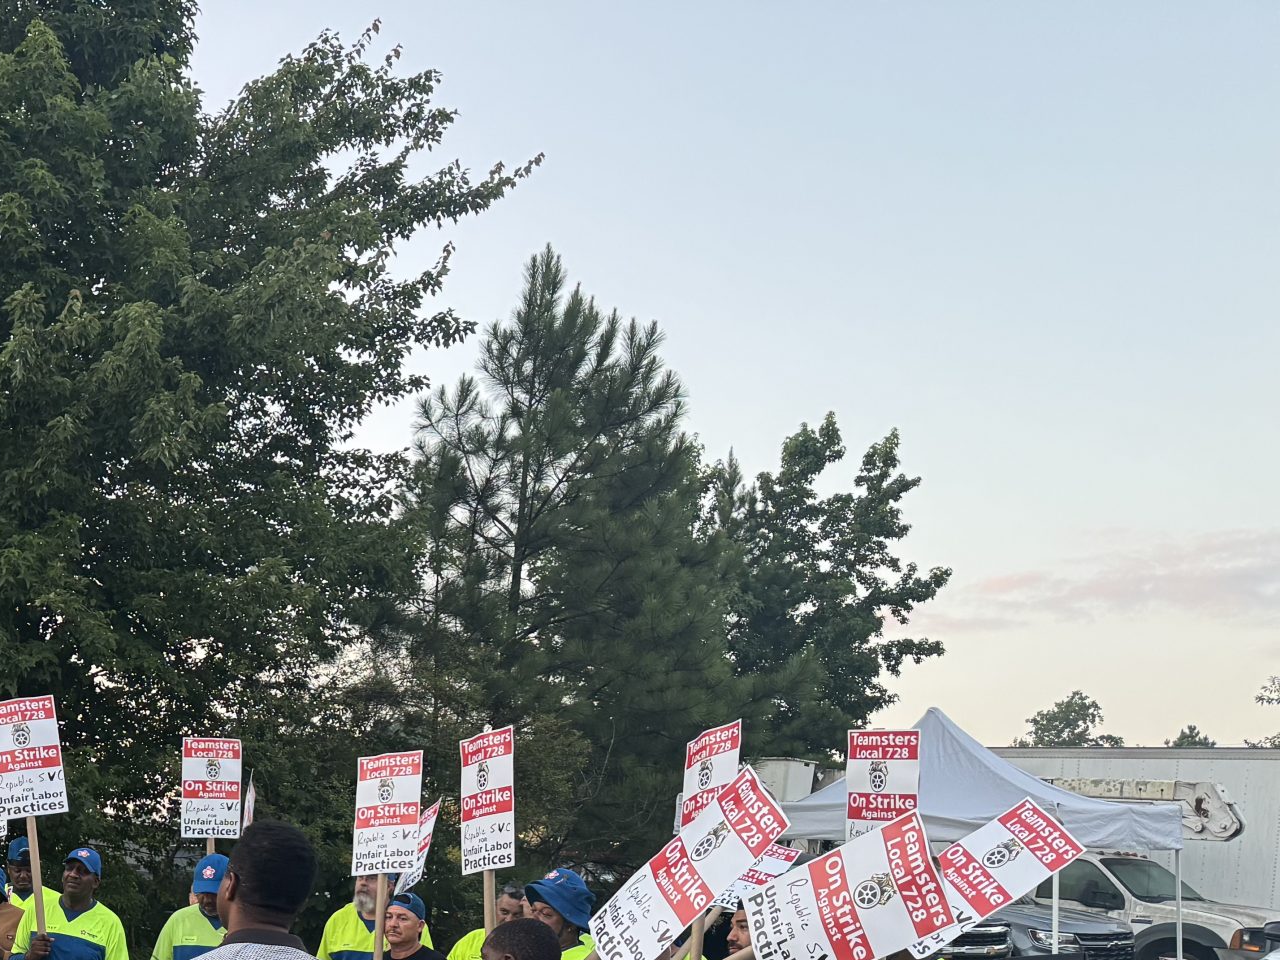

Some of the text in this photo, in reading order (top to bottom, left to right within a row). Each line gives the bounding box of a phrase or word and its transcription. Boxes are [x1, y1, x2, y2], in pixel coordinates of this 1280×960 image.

[25, 711, 45, 720] 728
[185, 740, 239, 749] Teamsters
[463, 732, 510, 754] Teamsters
[689, 726, 738, 753] Teamsters
[851, 733, 917, 747] Teamsters
[15, 747, 56, 761] Strike
[468, 746, 504, 764] Local 728
[691, 741, 731, 765] Local 728
[856, 747, 908, 758] Local 728
[8, 760, 42, 771] Against
[362, 754, 419, 770] Teamsters
[367, 767, 412, 779] Local 728
[185, 782, 238, 791] On Strike
[32, 790, 63, 801] Labor
[463, 789, 510, 810] On Strike
[850, 795, 914, 809] On Strike
[358, 809, 374, 819] On
[378, 804, 416, 816] Strike
[472, 805, 496, 817] Against
[684, 797, 695, 813] On
[736, 771, 781, 839] Teamsters
[369, 817, 400, 826] Against
[721, 793, 743, 825] Local
[737, 824, 762, 848] 728
[862, 809, 897, 819] Against
[185, 826, 237, 836] Practices
[1015, 802, 1075, 860] Teamsters
[1005, 818, 1052, 863] Local 728
[356, 849, 414, 860] Unfair Labor
[464, 841, 512, 857] Unfair Labor
[355, 858, 413, 872] Practices
[464, 853, 512, 870] Practices
[666, 840, 707, 909] On Strike
[886, 837, 927, 922] Local 728
[901, 817, 947, 927] Teamsters
[945, 847, 1004, 905] On Strike
[657, 867, 681, 904] Against
[945, 867, 976, 899] Against
[608, 896, 626, 931] Unfair
[764, 885, 786, 936] Unfair
[817, 889, 842, 941] Against
[825, 856, 866, 960] On Strike
[626, 910, 637, 924] FOR
[786, 922, 795, 940] FOR
